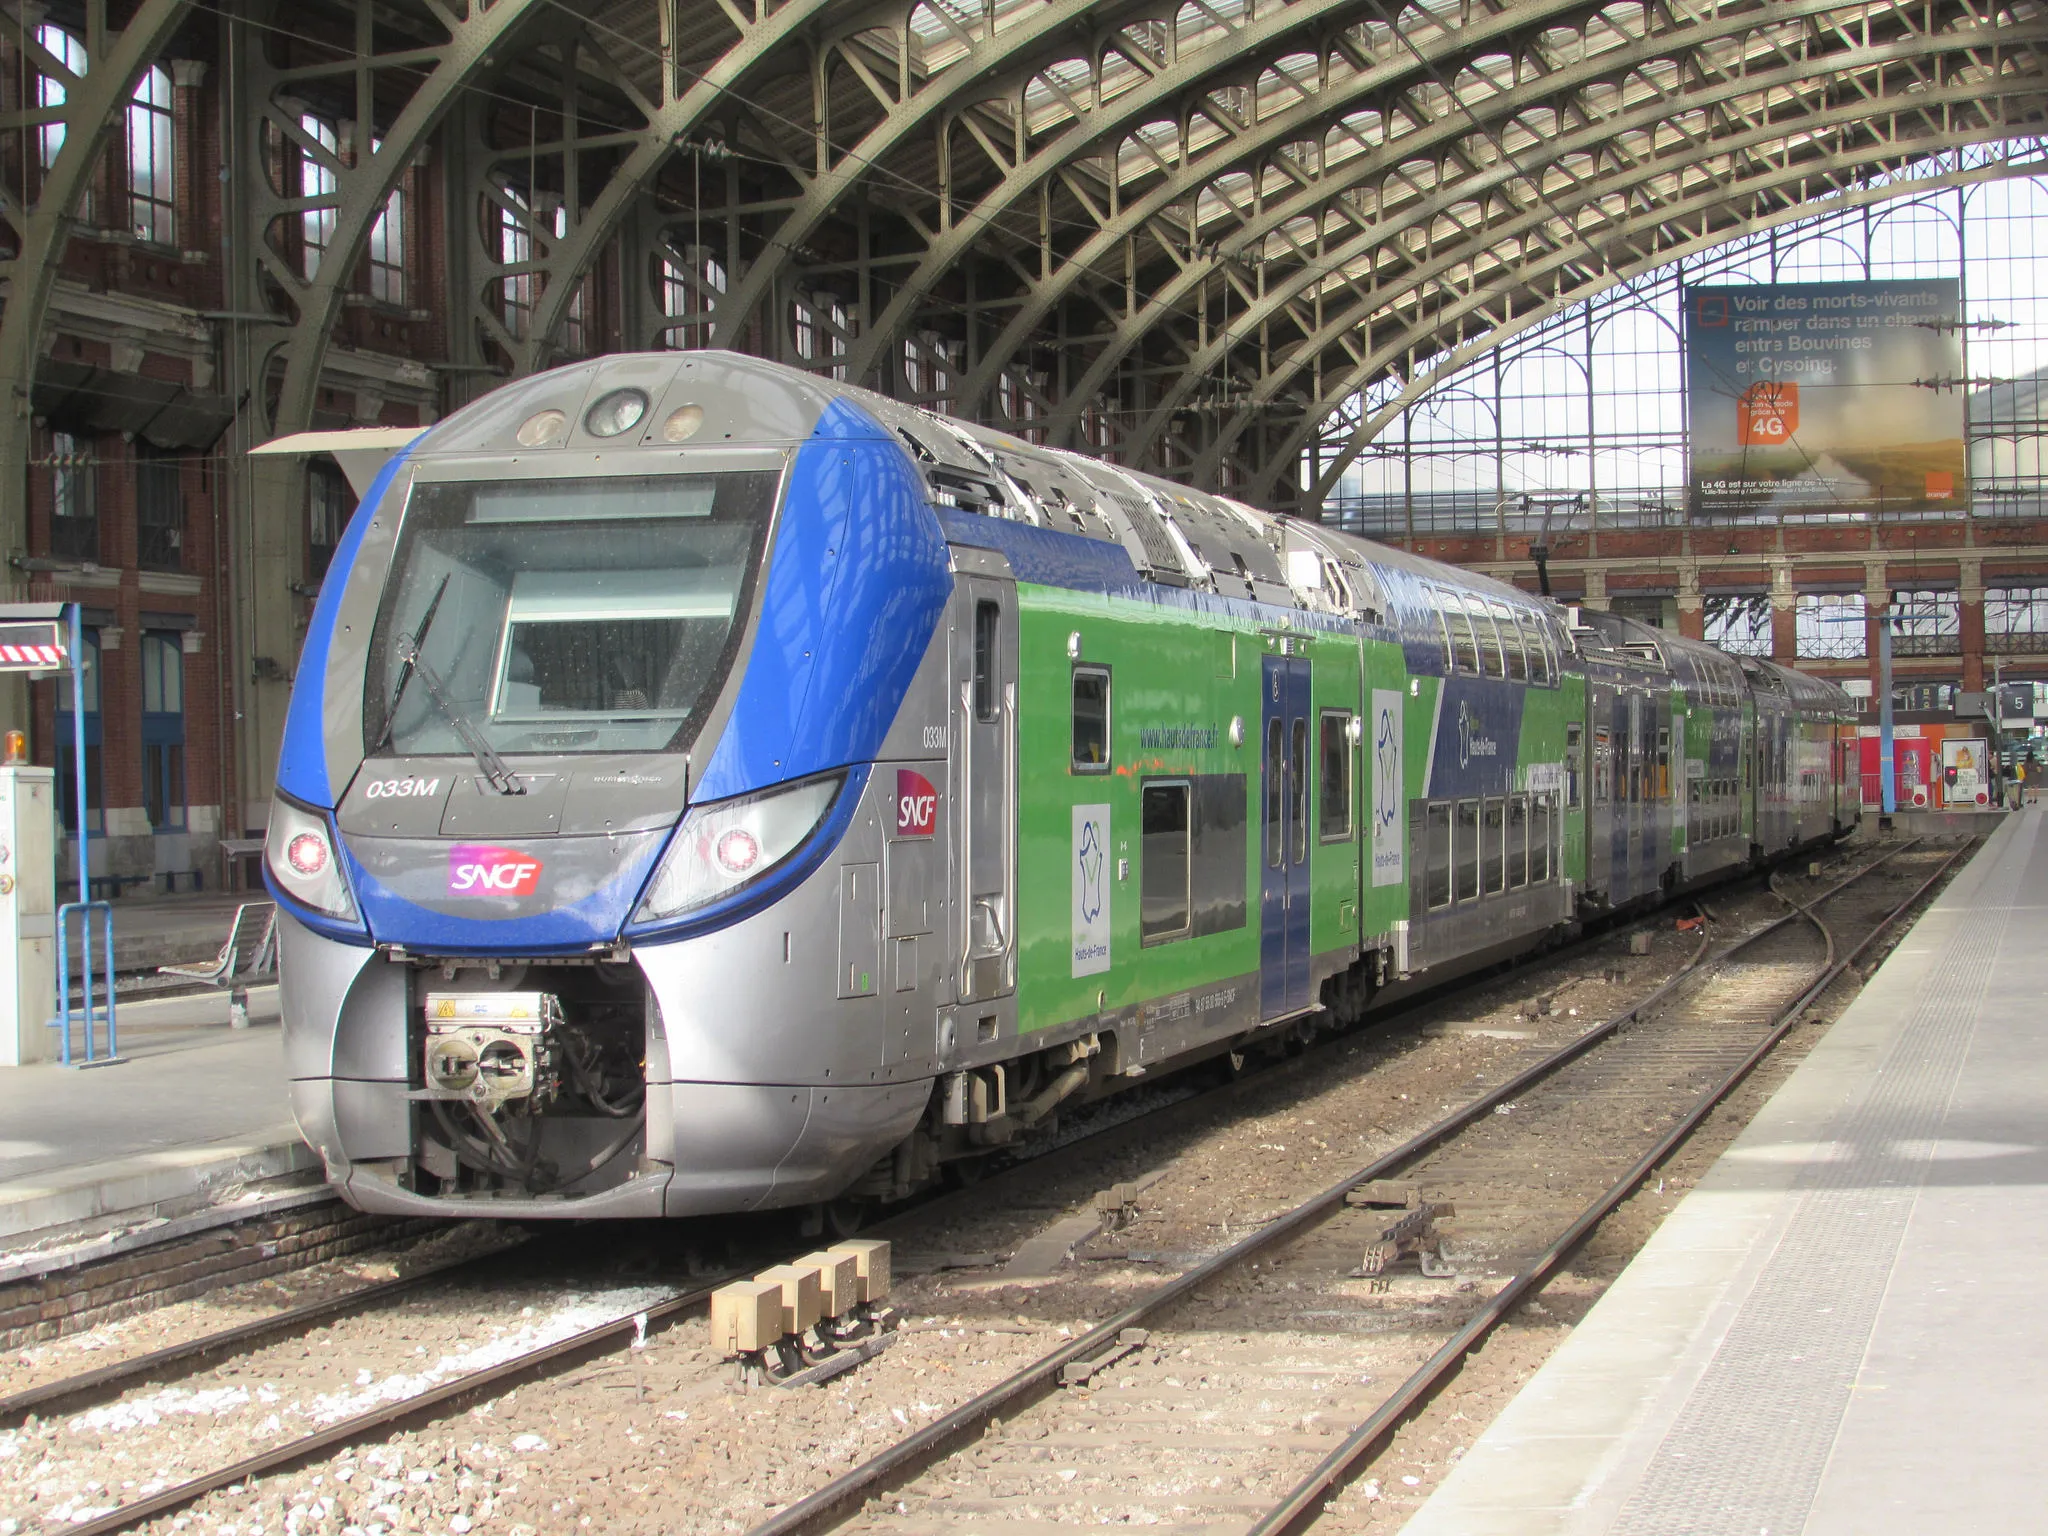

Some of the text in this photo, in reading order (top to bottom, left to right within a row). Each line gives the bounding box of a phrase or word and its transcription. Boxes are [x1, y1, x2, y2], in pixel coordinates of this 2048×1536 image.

[1733, 291, 1938, 312] Voir des morts-vivants
[1734, 317, 1801, 334] ramper
[1806, 314, 1851, 330] dans
[1856, 316, 1879, 328] un
[1735, 335, 1873, 353] entre Bouvines
[1759, 356, 1838, 375] Cysoing.
[1753, 418, 1783, 435] 4G
[1701, 481, 1711, 489] La
[1713, 481, 1726, 489] 4G
[1728, 480, 1741, 488] est
[1759, 480, 1780, 488] votre
[1782, 479, 1803, 489] ligne
[2014, 696, 2024, 710] 5
[923, 726, 947, 749] 033M
[1140, 721, 1219, 749] www.hautsdefrance.fr
[366, 778, 440, 799] 033M
[898, 795, 936, 827] SNCF
[451, 863, 538, 890] SNCF
